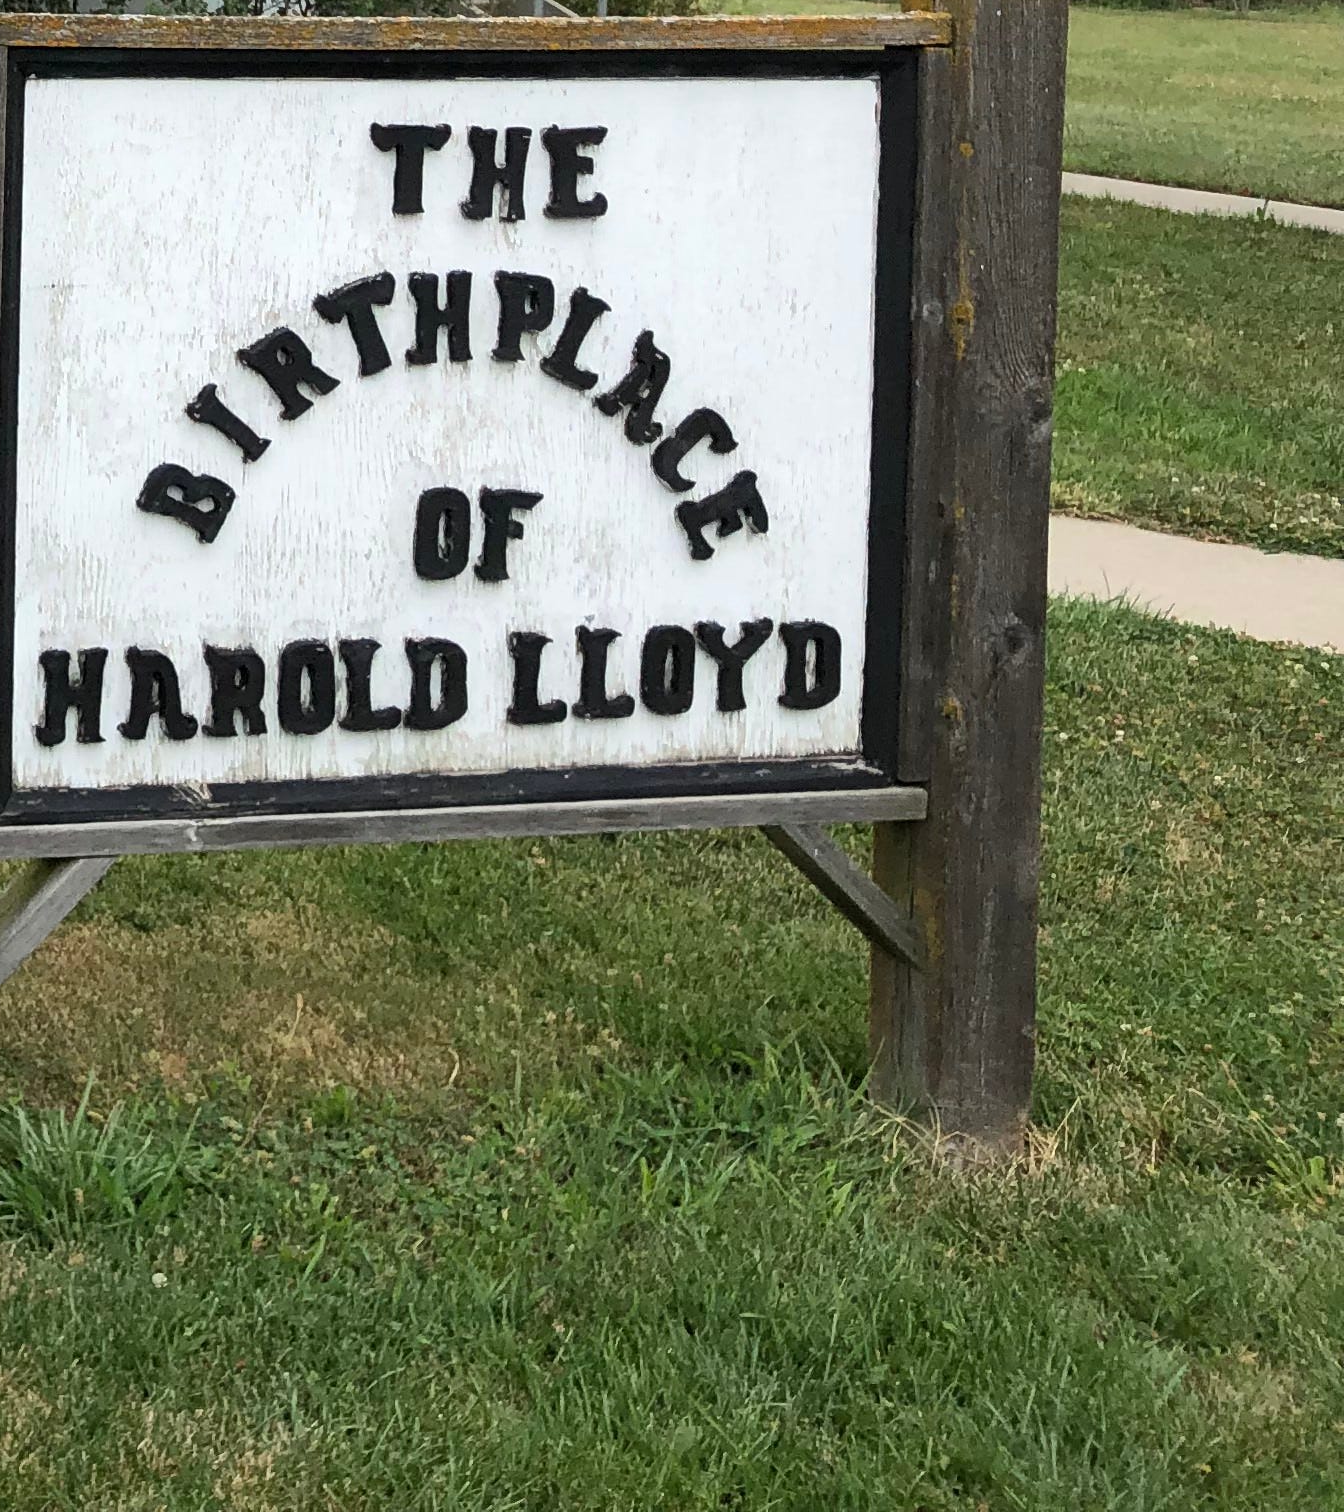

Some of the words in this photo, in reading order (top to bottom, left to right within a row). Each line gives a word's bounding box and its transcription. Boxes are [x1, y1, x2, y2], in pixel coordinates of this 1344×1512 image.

[369, 122, 608, 224] THE
[135, 269, 769, 561] BIRTHPLACE
[412, 486, 545, 585] OF
[34, 635, 469, 750] HAROLD
[505, 616, 843, 727] LLOYD
